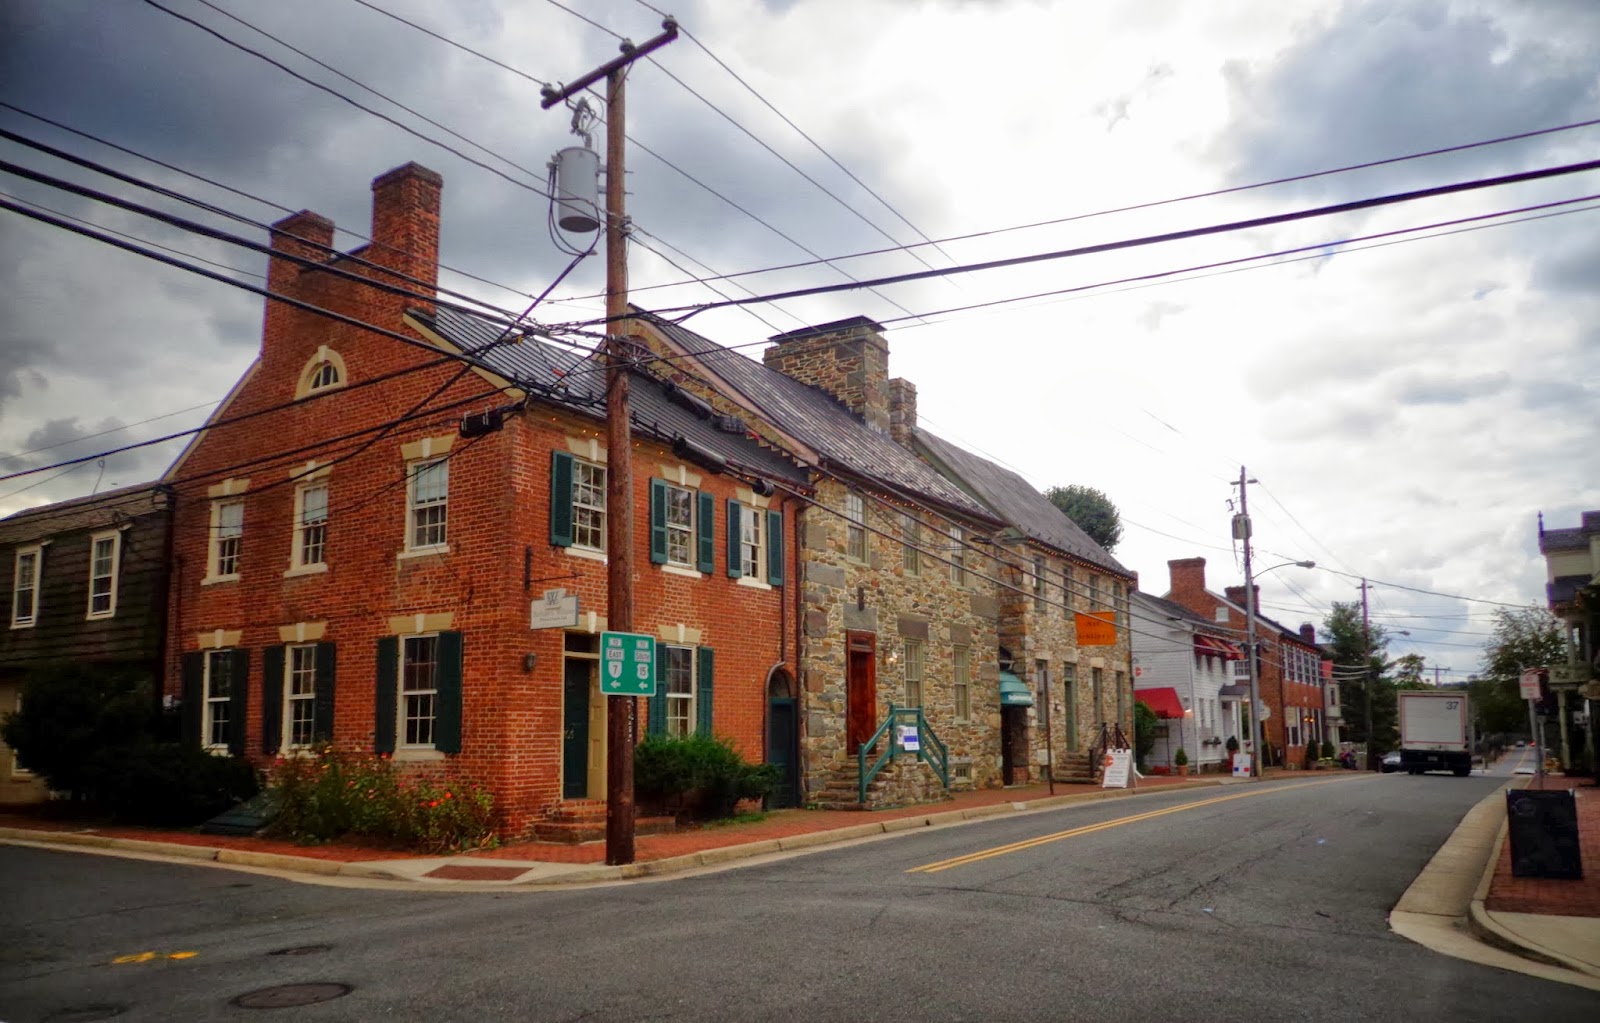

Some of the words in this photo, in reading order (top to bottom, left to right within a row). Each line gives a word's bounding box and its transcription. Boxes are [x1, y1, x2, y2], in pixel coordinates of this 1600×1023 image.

[608, 650, 622, 658] EAST
[612, 664, 618, 675] 7
[639, 666, 647, 676] 15
[1446, 701, 1459, 710] 37
